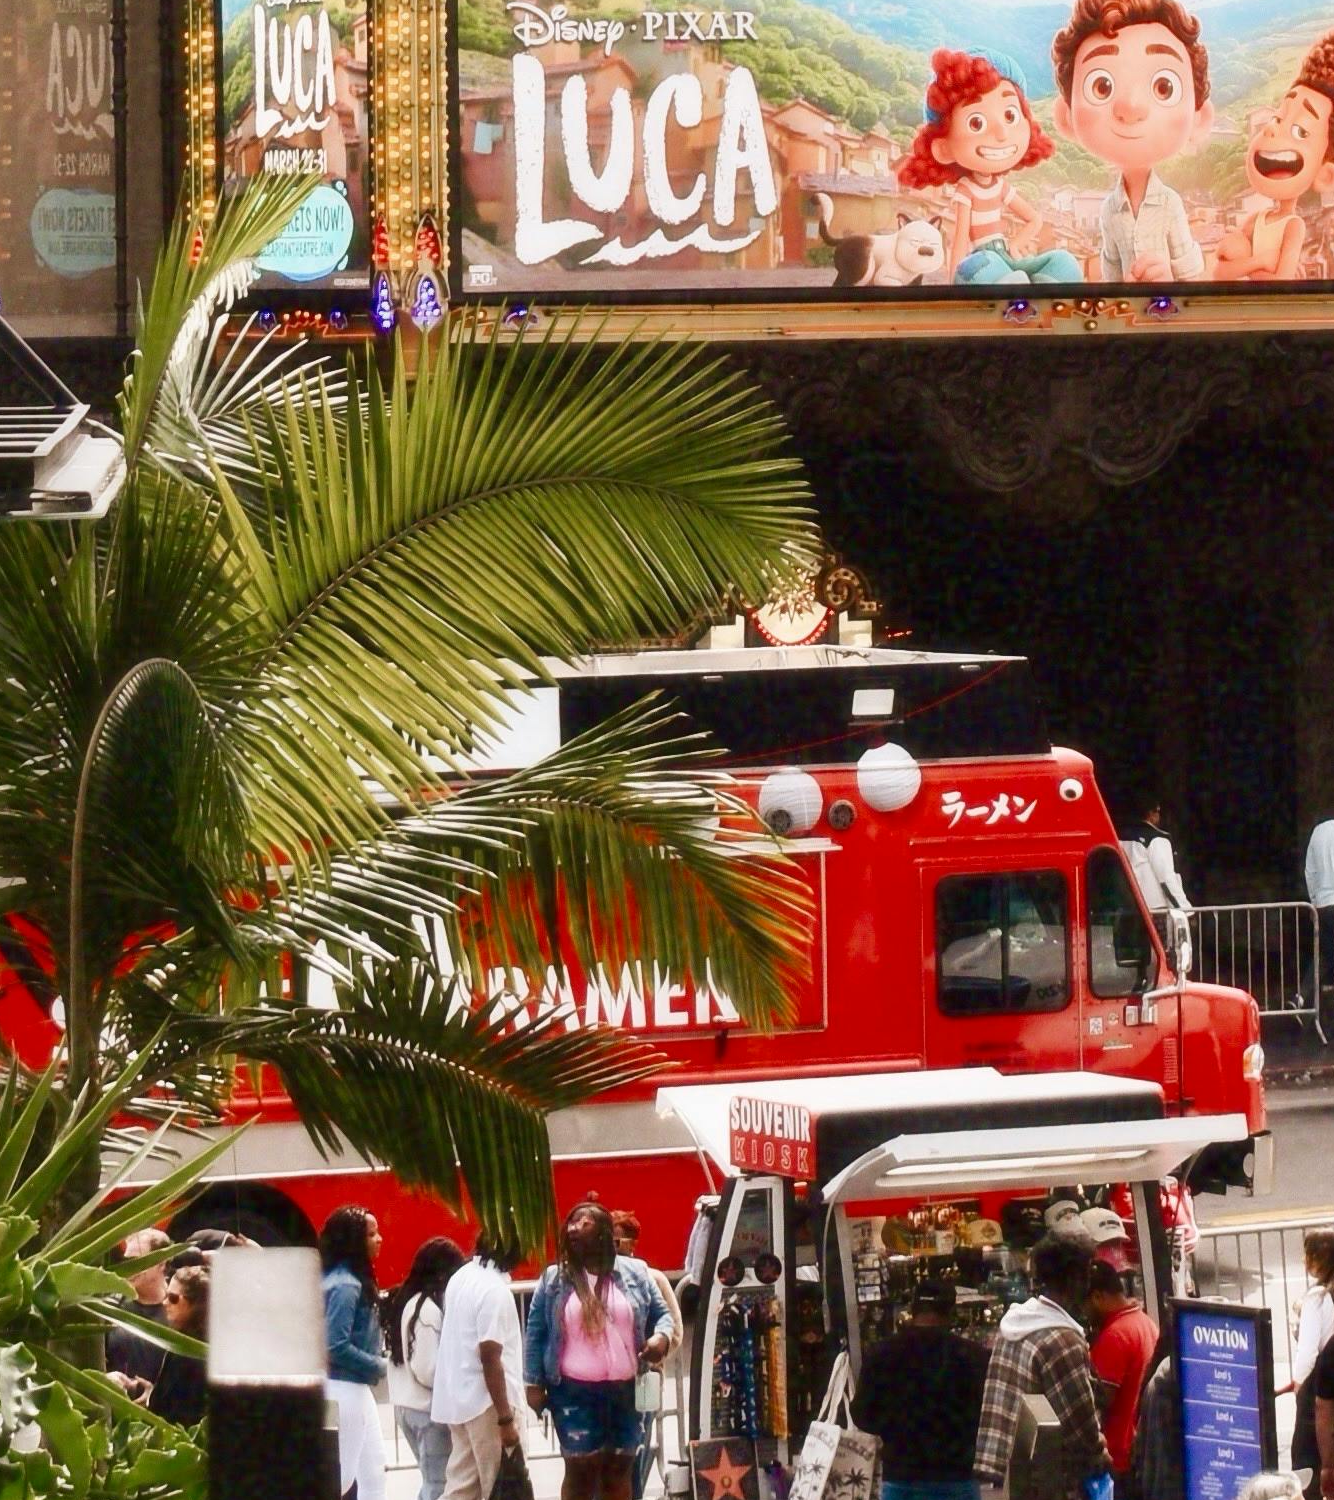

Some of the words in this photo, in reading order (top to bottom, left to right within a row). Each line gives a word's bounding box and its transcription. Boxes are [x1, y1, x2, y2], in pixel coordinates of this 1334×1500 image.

[507, 1, 624, 56] Disney
[641, 11, 759, 41] PIXAR
[254, 3, 337, 138] LUCA
[264, 149, 300, 176] MARCH
[513, 53, 778, 265] LUCA
[316, 204, 345, 232] NOW!
[941, 791, 1038, 829] ラーメン
[730, 1097, 811, 1142] SOUVENIR
[733, 1135, 809, 1174] KIOSK
[1193, 1323, 1249, 1351] OVATION
